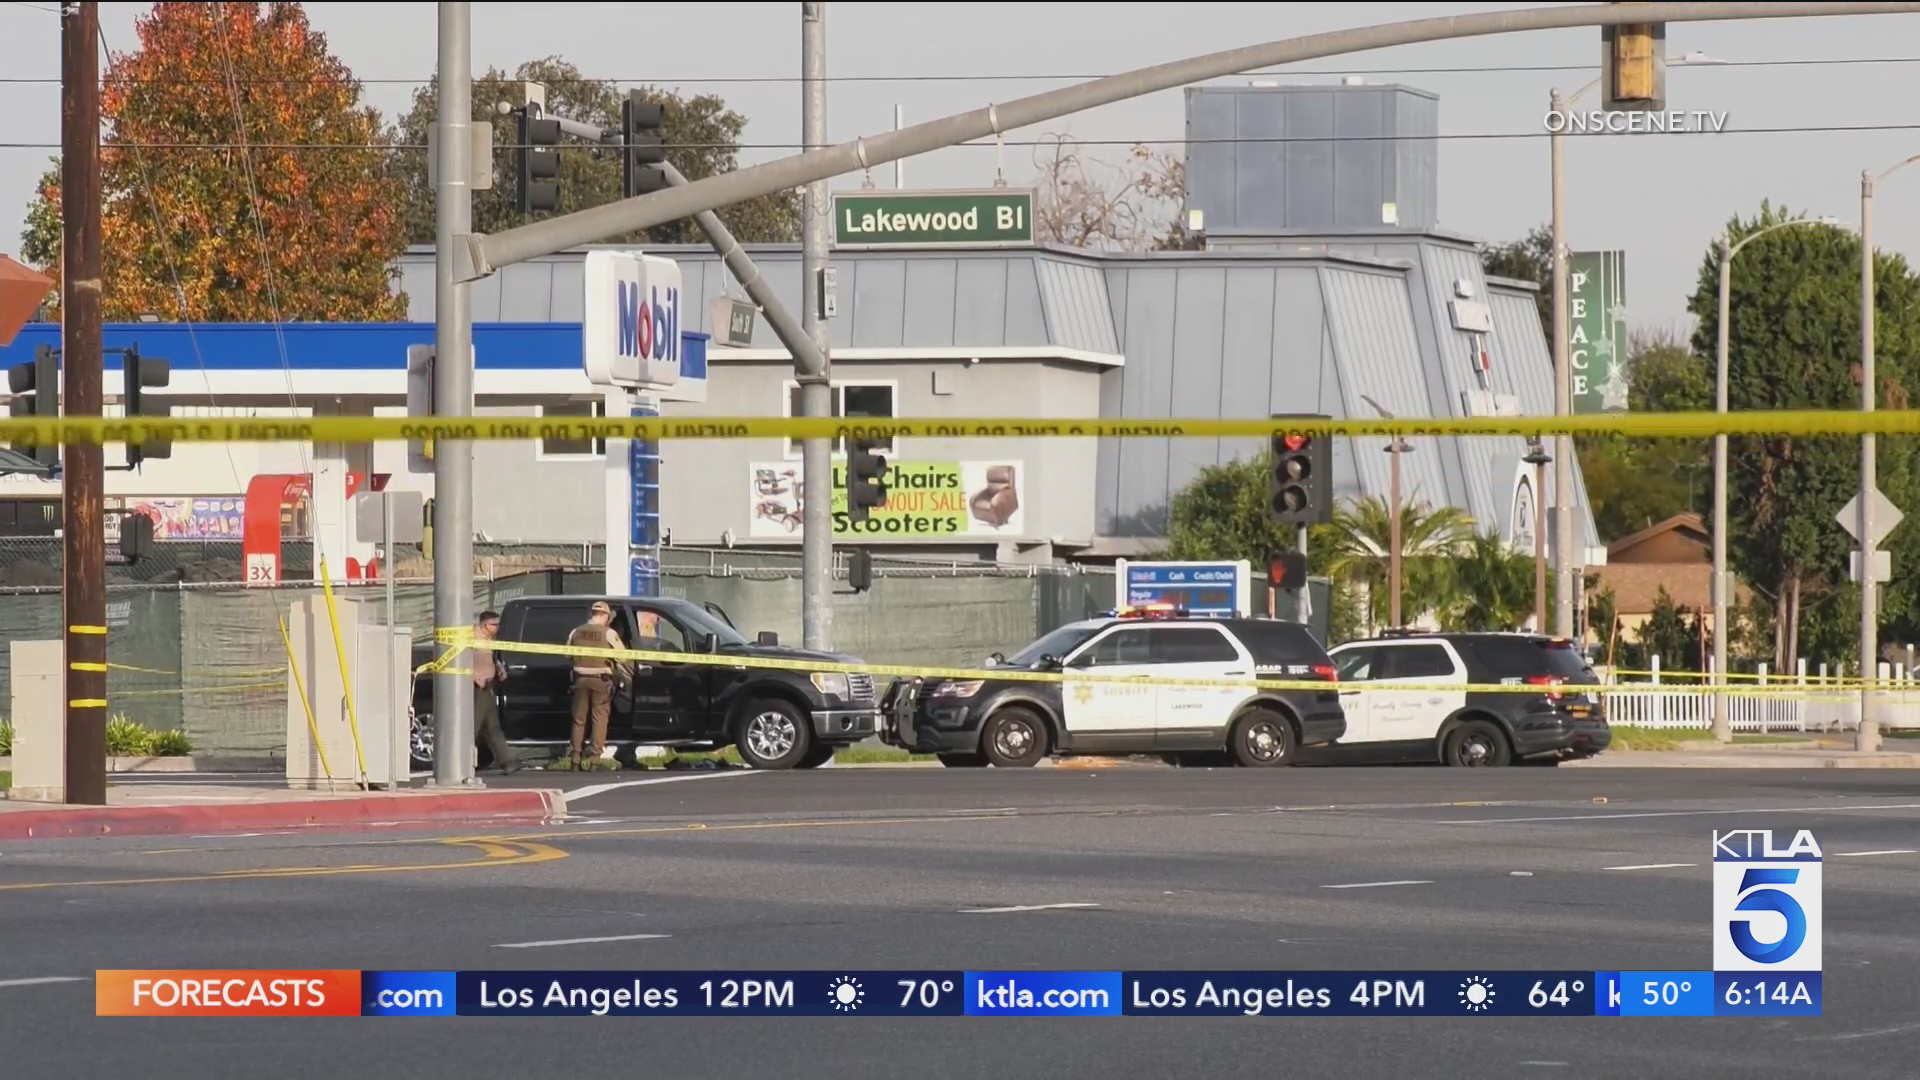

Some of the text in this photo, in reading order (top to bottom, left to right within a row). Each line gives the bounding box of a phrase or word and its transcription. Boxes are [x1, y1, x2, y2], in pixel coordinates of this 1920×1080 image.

[845, 206, 978, 232] Lakewood
[617, 279, 678, 362] Mobil
[1570, 272, 1589, 396] PEACE
[872, 491, 967, 511] WOUT SALE
[832, 511, 958, 533] Scooters
[249, 566, 273, 581] 3X
[1102, 686, 1149, 696] SHERIFF
